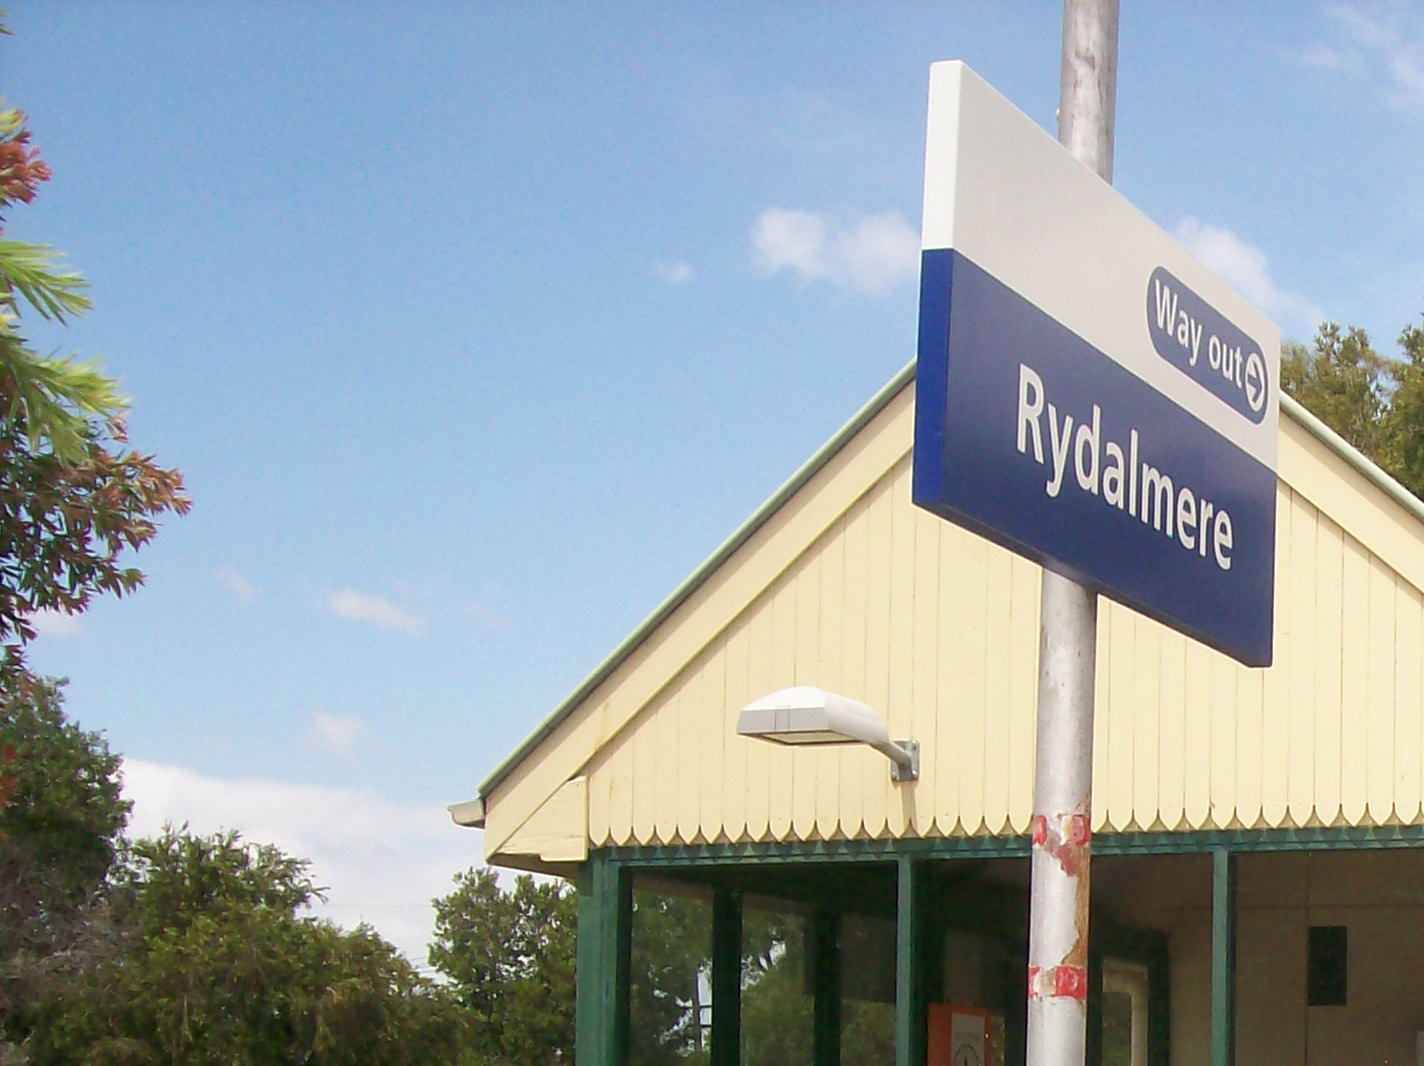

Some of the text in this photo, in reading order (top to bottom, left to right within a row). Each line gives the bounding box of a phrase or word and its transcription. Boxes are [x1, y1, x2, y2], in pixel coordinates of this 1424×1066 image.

[1154, 278, 1243, 389] Way out
[1016, 362, 1233, 570] Rydalmere
